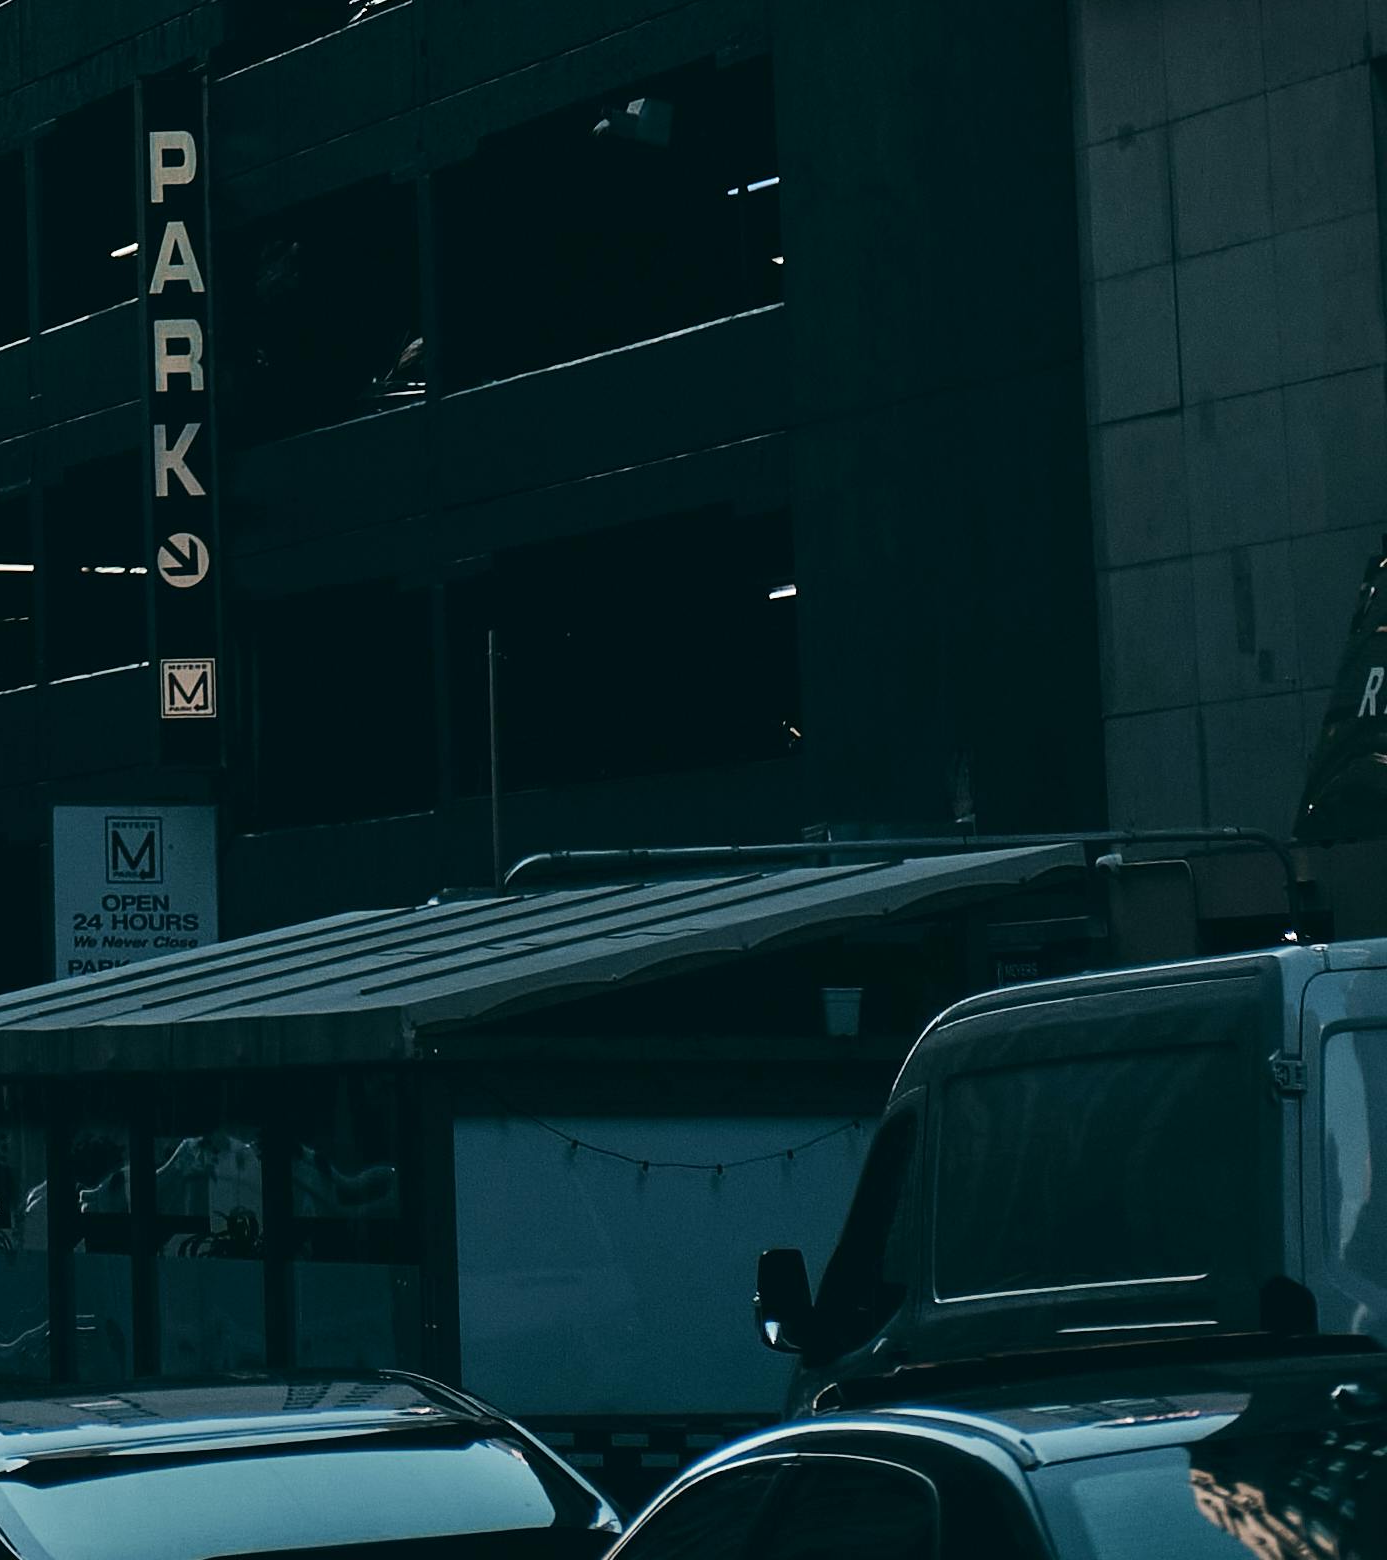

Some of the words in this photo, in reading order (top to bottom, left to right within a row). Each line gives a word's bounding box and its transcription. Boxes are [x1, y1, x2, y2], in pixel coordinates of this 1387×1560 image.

[147, 129, 207, 498] PARK
[101, 894, 170, 912] OPEN
[73, 913, 103, 931] 24
[111, 913, 200, 932] HOURS
[73, 935, 98, 948] We
[101, 935, 149, 949] Never
[153, 935, 199, 949] Close
